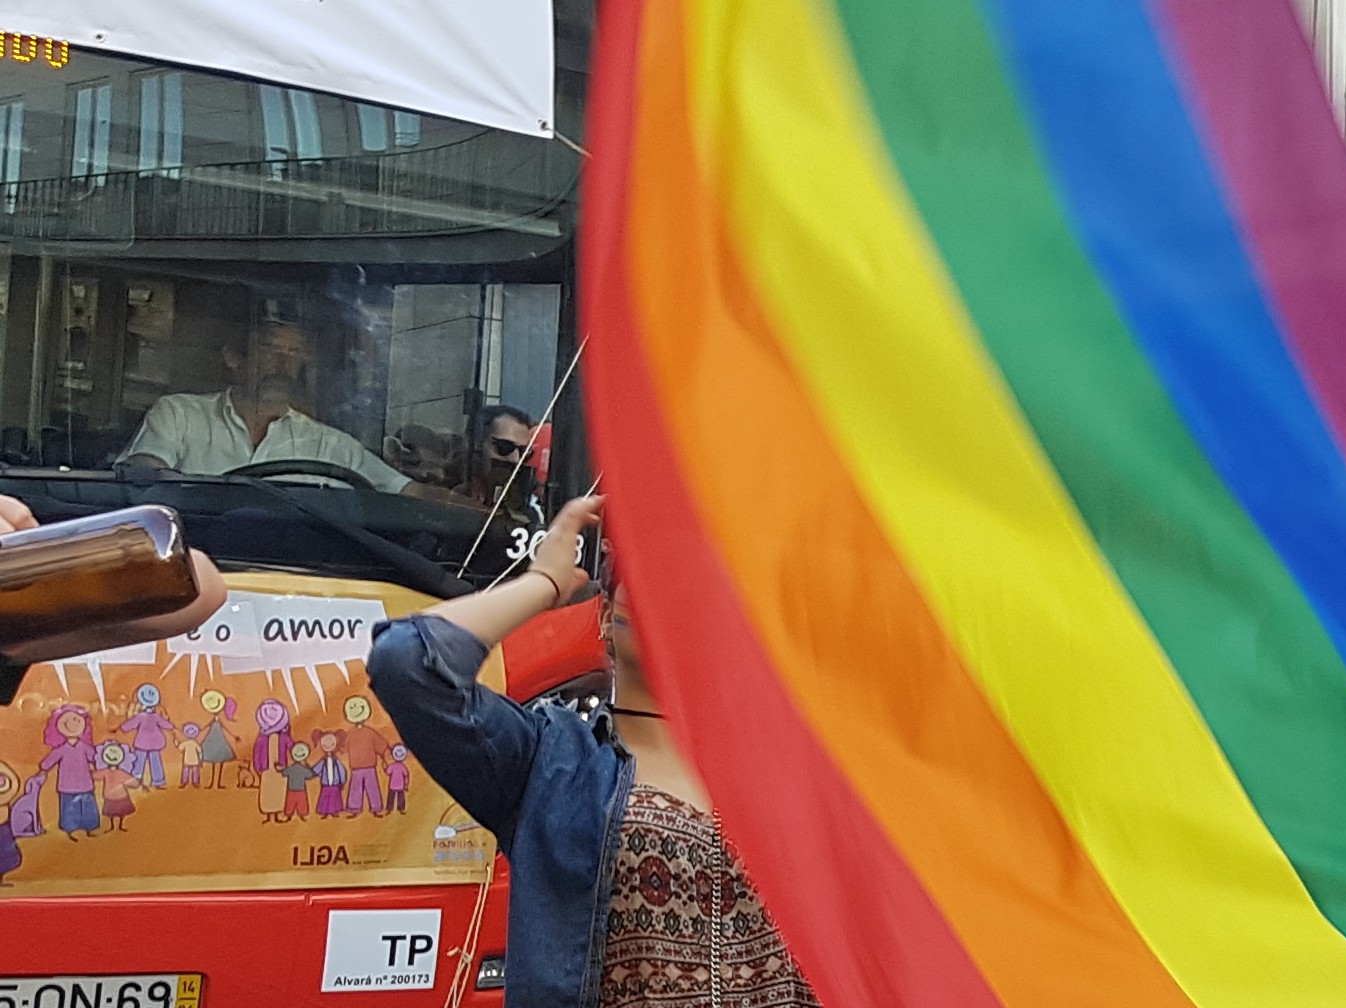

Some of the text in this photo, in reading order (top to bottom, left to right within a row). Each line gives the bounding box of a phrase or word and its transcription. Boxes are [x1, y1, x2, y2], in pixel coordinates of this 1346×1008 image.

[215, 624, 231, 642] o
[263, 617, 364, 642] amor
[381, 934, 434, 967] TP
[182, 980, 195, 994] 14
[333, 975, 372, 987] Alvará
[390, 973, 430, 985] 200173
